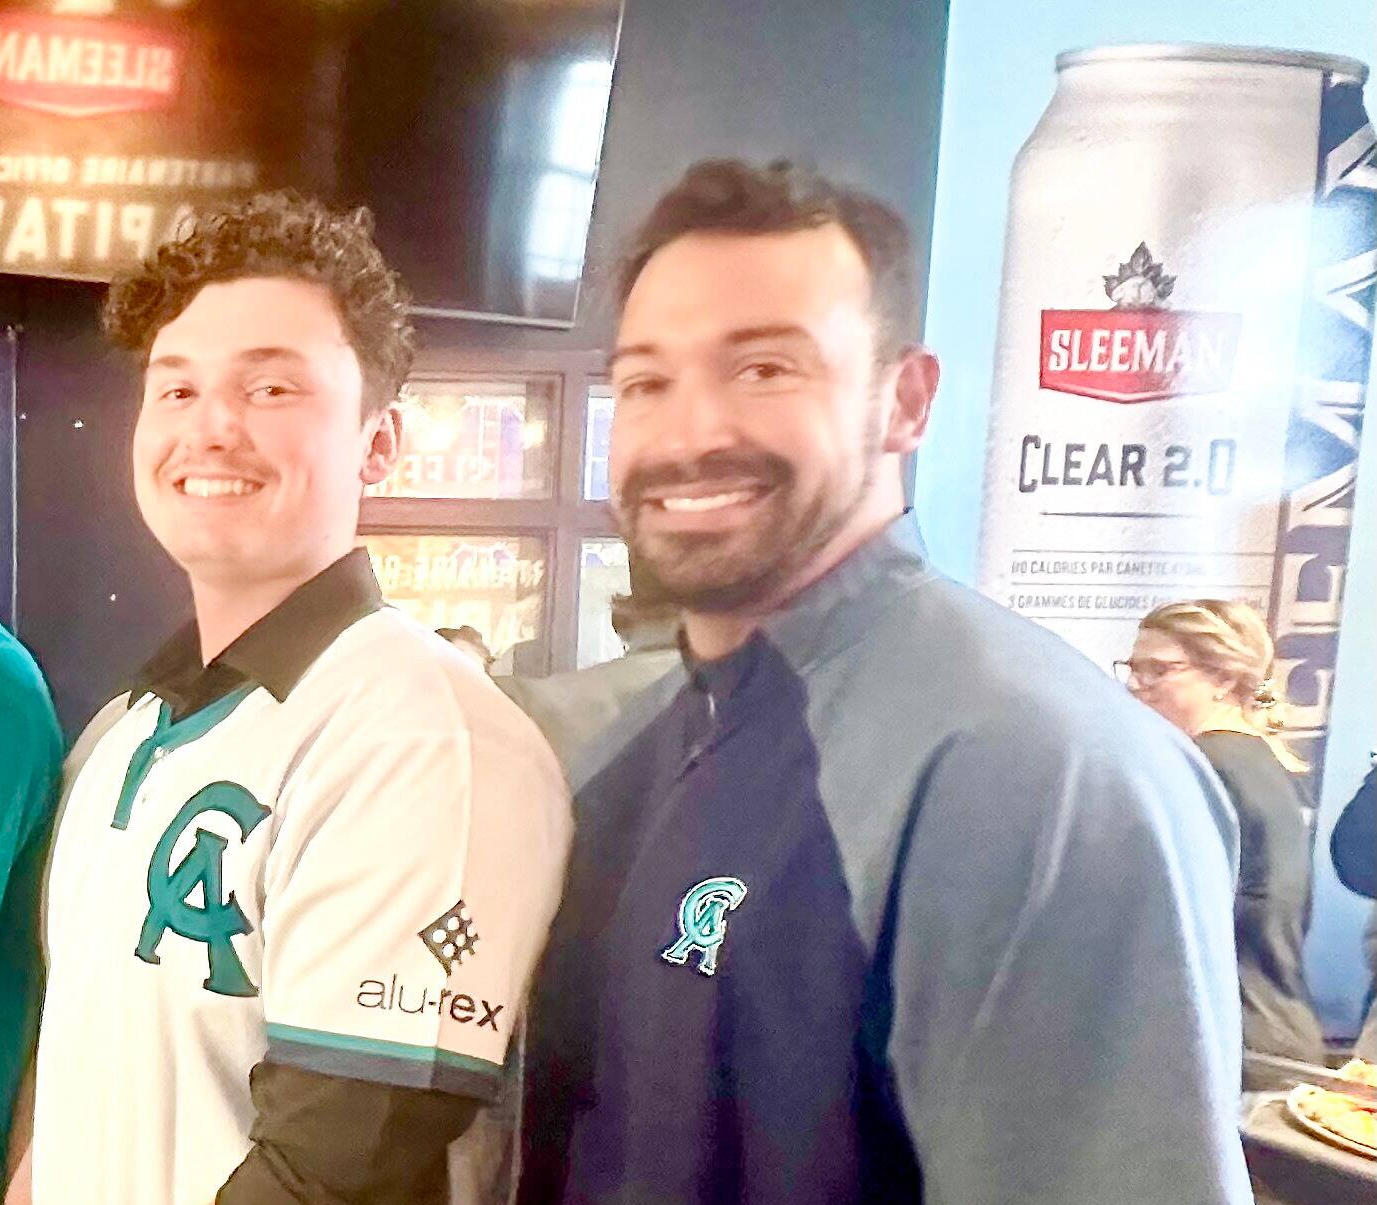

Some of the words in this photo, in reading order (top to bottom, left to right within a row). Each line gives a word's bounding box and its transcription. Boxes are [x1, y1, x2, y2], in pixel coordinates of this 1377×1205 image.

[1048, 328, 1225, 374] SLEEMAN
[1019, 434, 1148, 494] CLEAR
[1163, 438, 1238, 496] 2.0
[1090, 562, 1113, 575] PAR
[356, 973, 504, 1033] alu-rex
